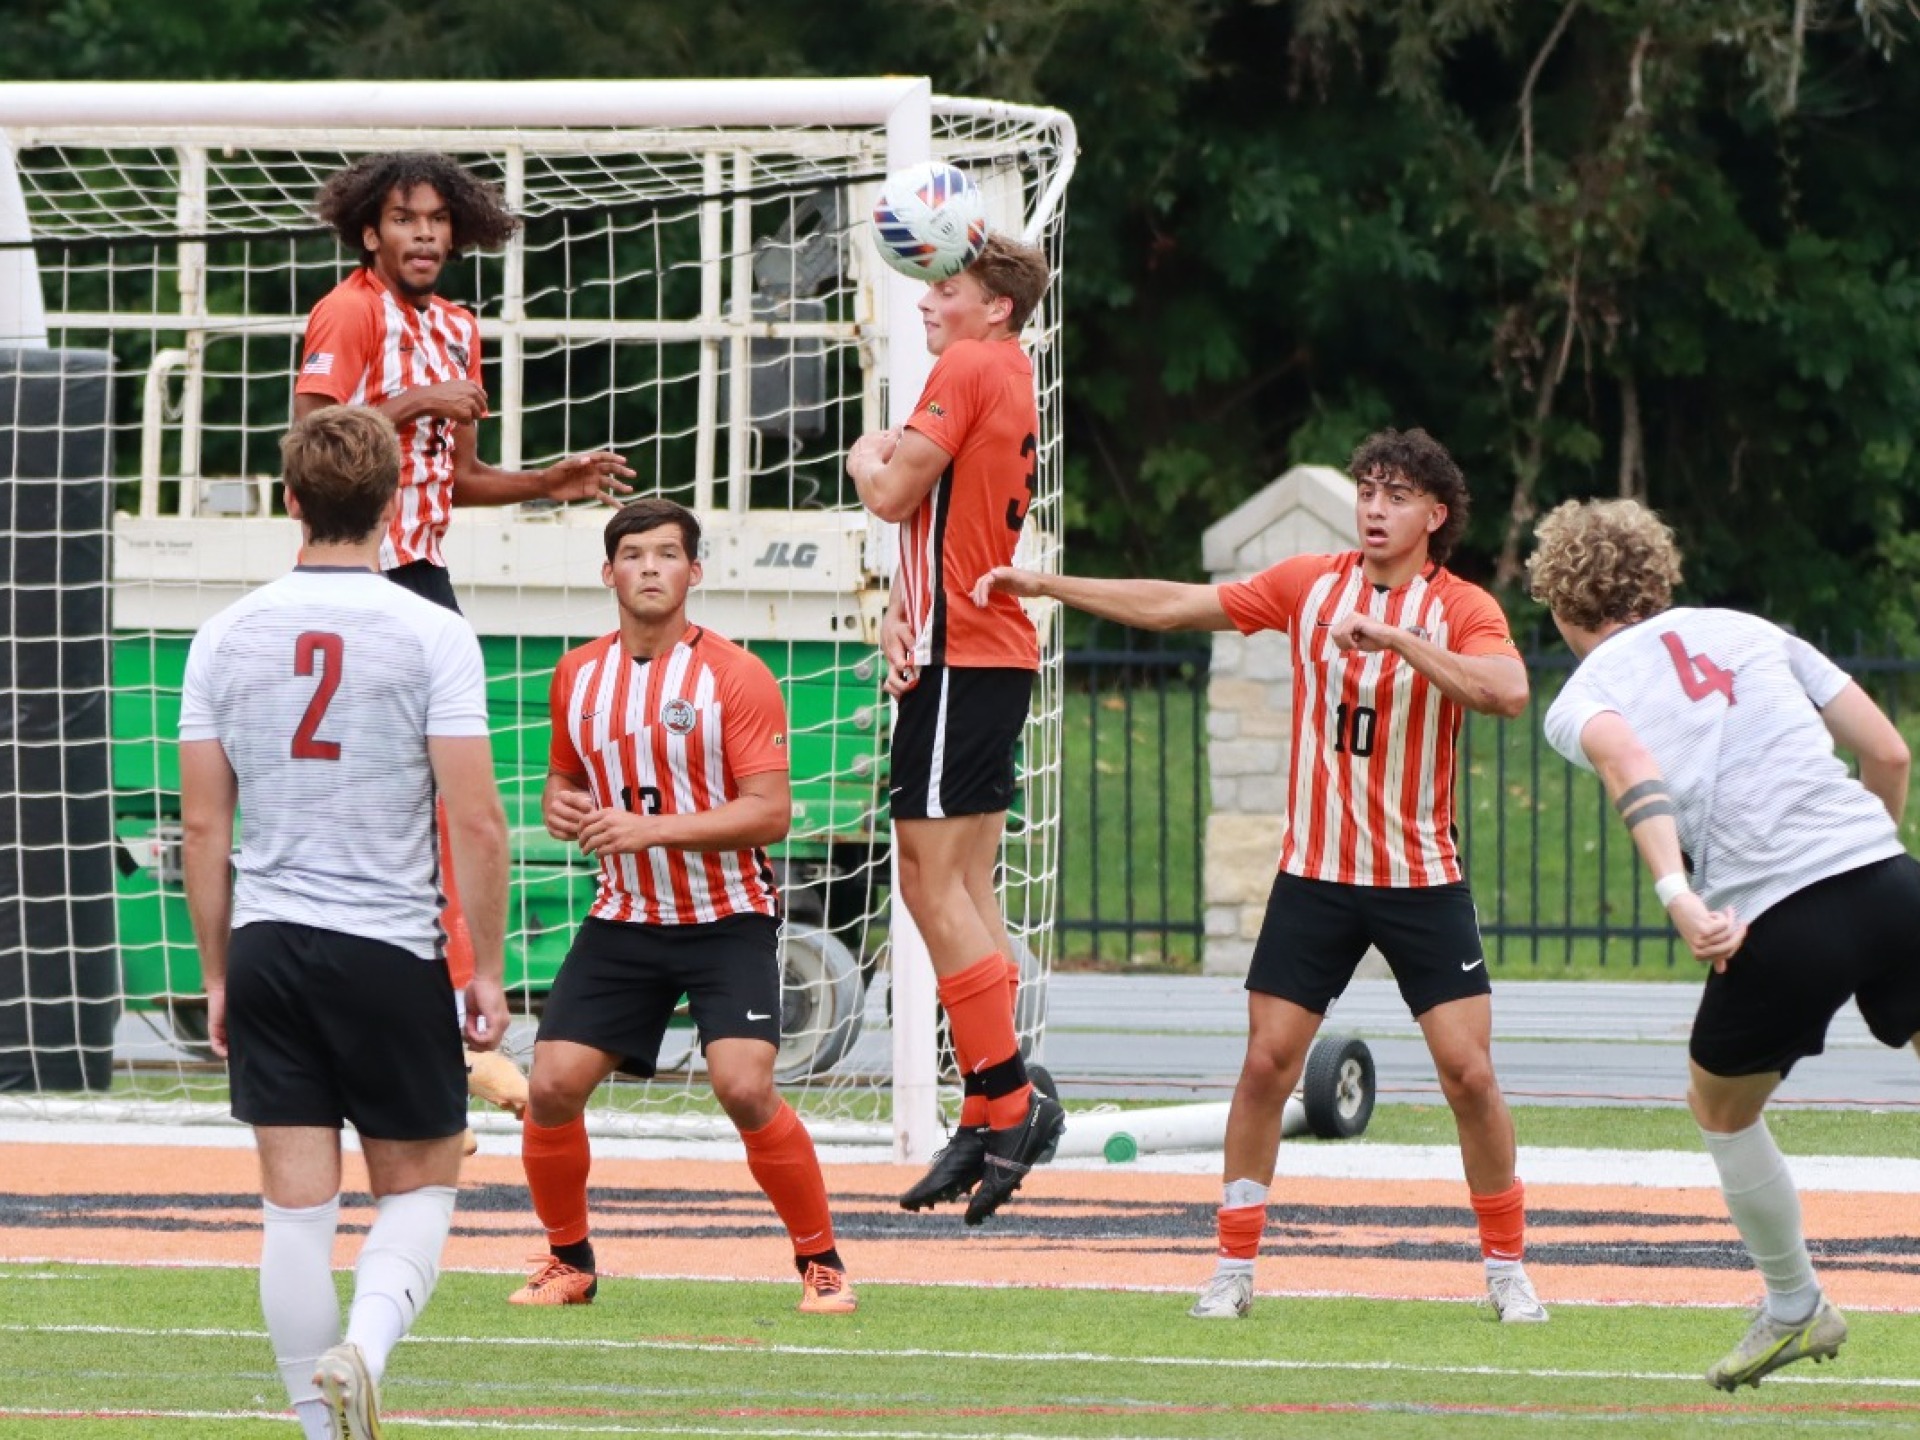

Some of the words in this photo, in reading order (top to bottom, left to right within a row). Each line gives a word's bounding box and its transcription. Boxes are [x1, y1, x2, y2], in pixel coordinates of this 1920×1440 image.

[753, 542, 819, 568] JLG
[291, 631, 344, 760] 2
[1660, 631, 1738, 706] 4
[1335, 702, 1377, 757] 10
